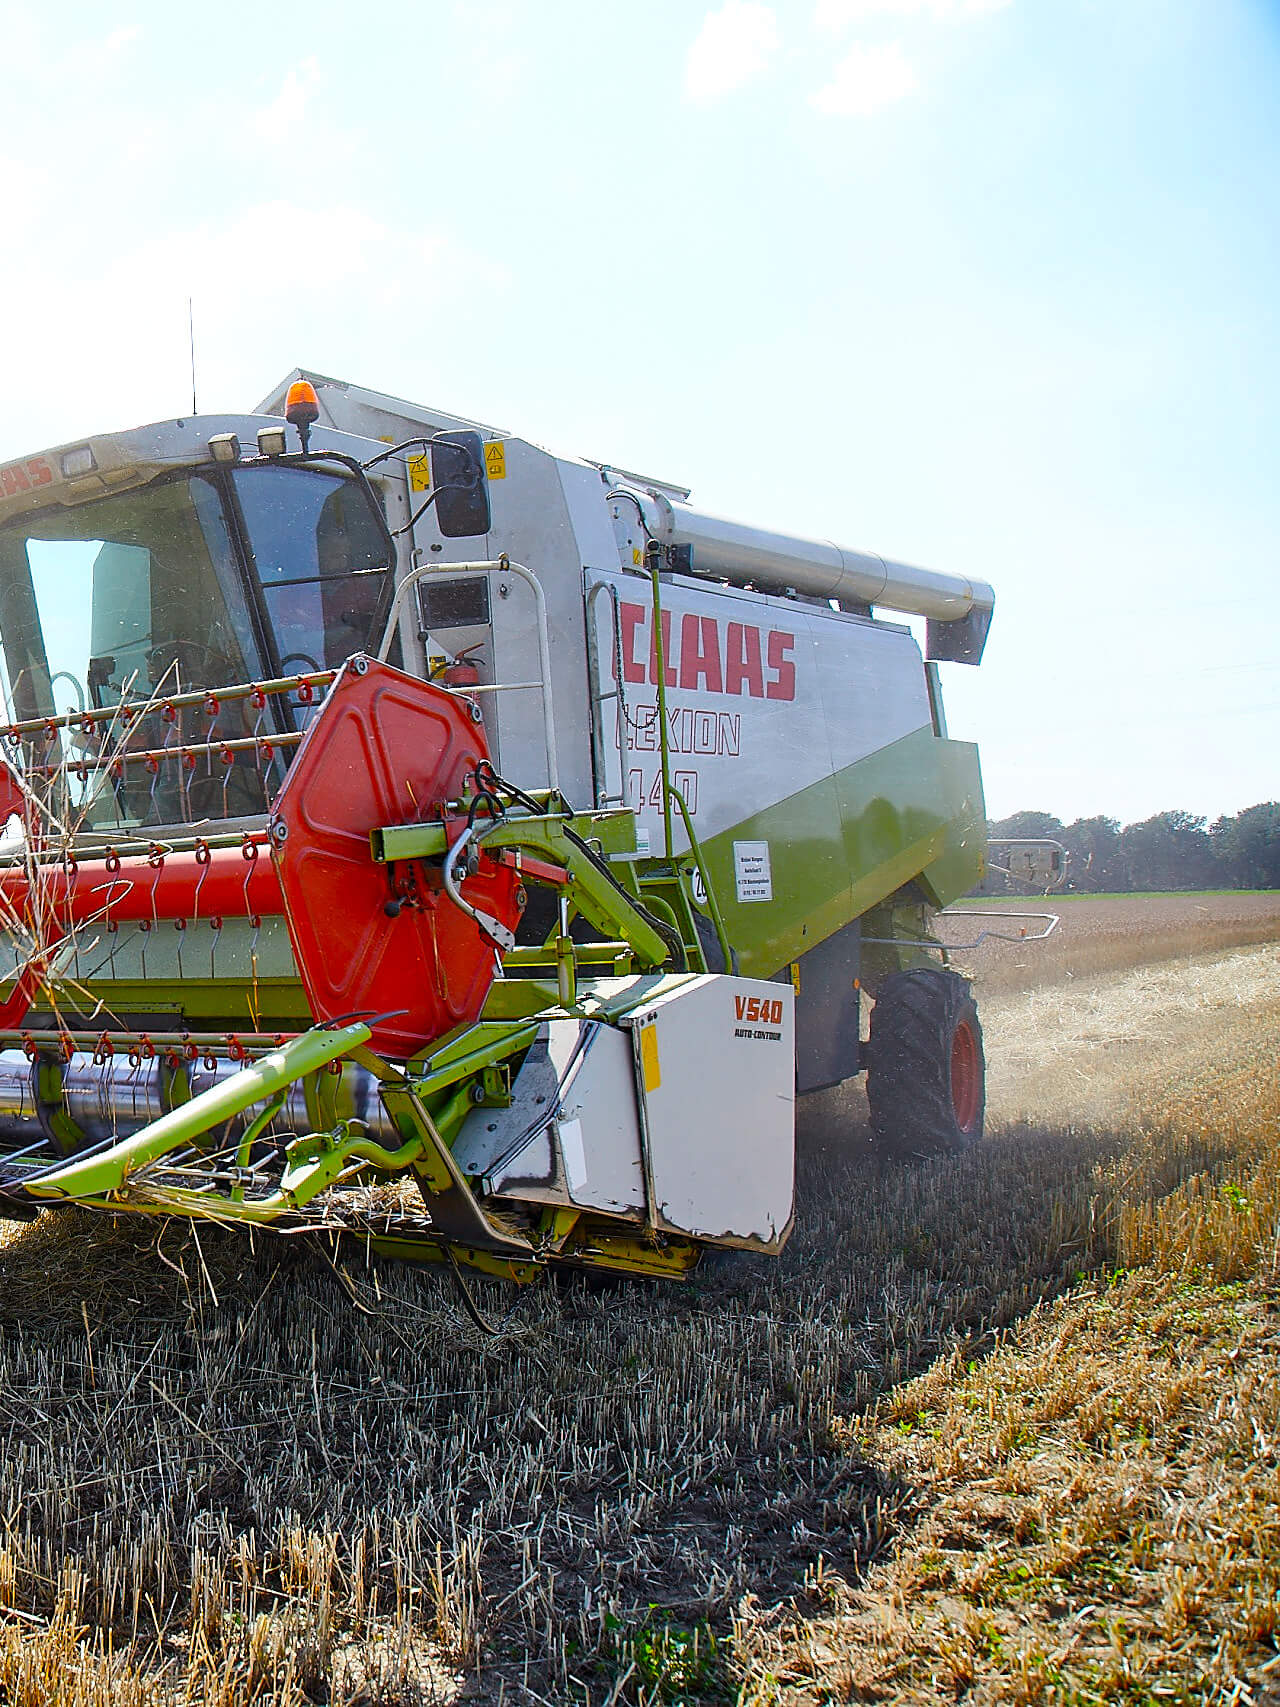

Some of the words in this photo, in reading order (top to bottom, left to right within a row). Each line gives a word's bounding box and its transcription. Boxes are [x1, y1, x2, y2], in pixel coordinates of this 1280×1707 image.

[612, 602, 795, 701] CLAAS
[616, 704, 741, 756] LEXION
[735, 995, 783, 1024] V540
